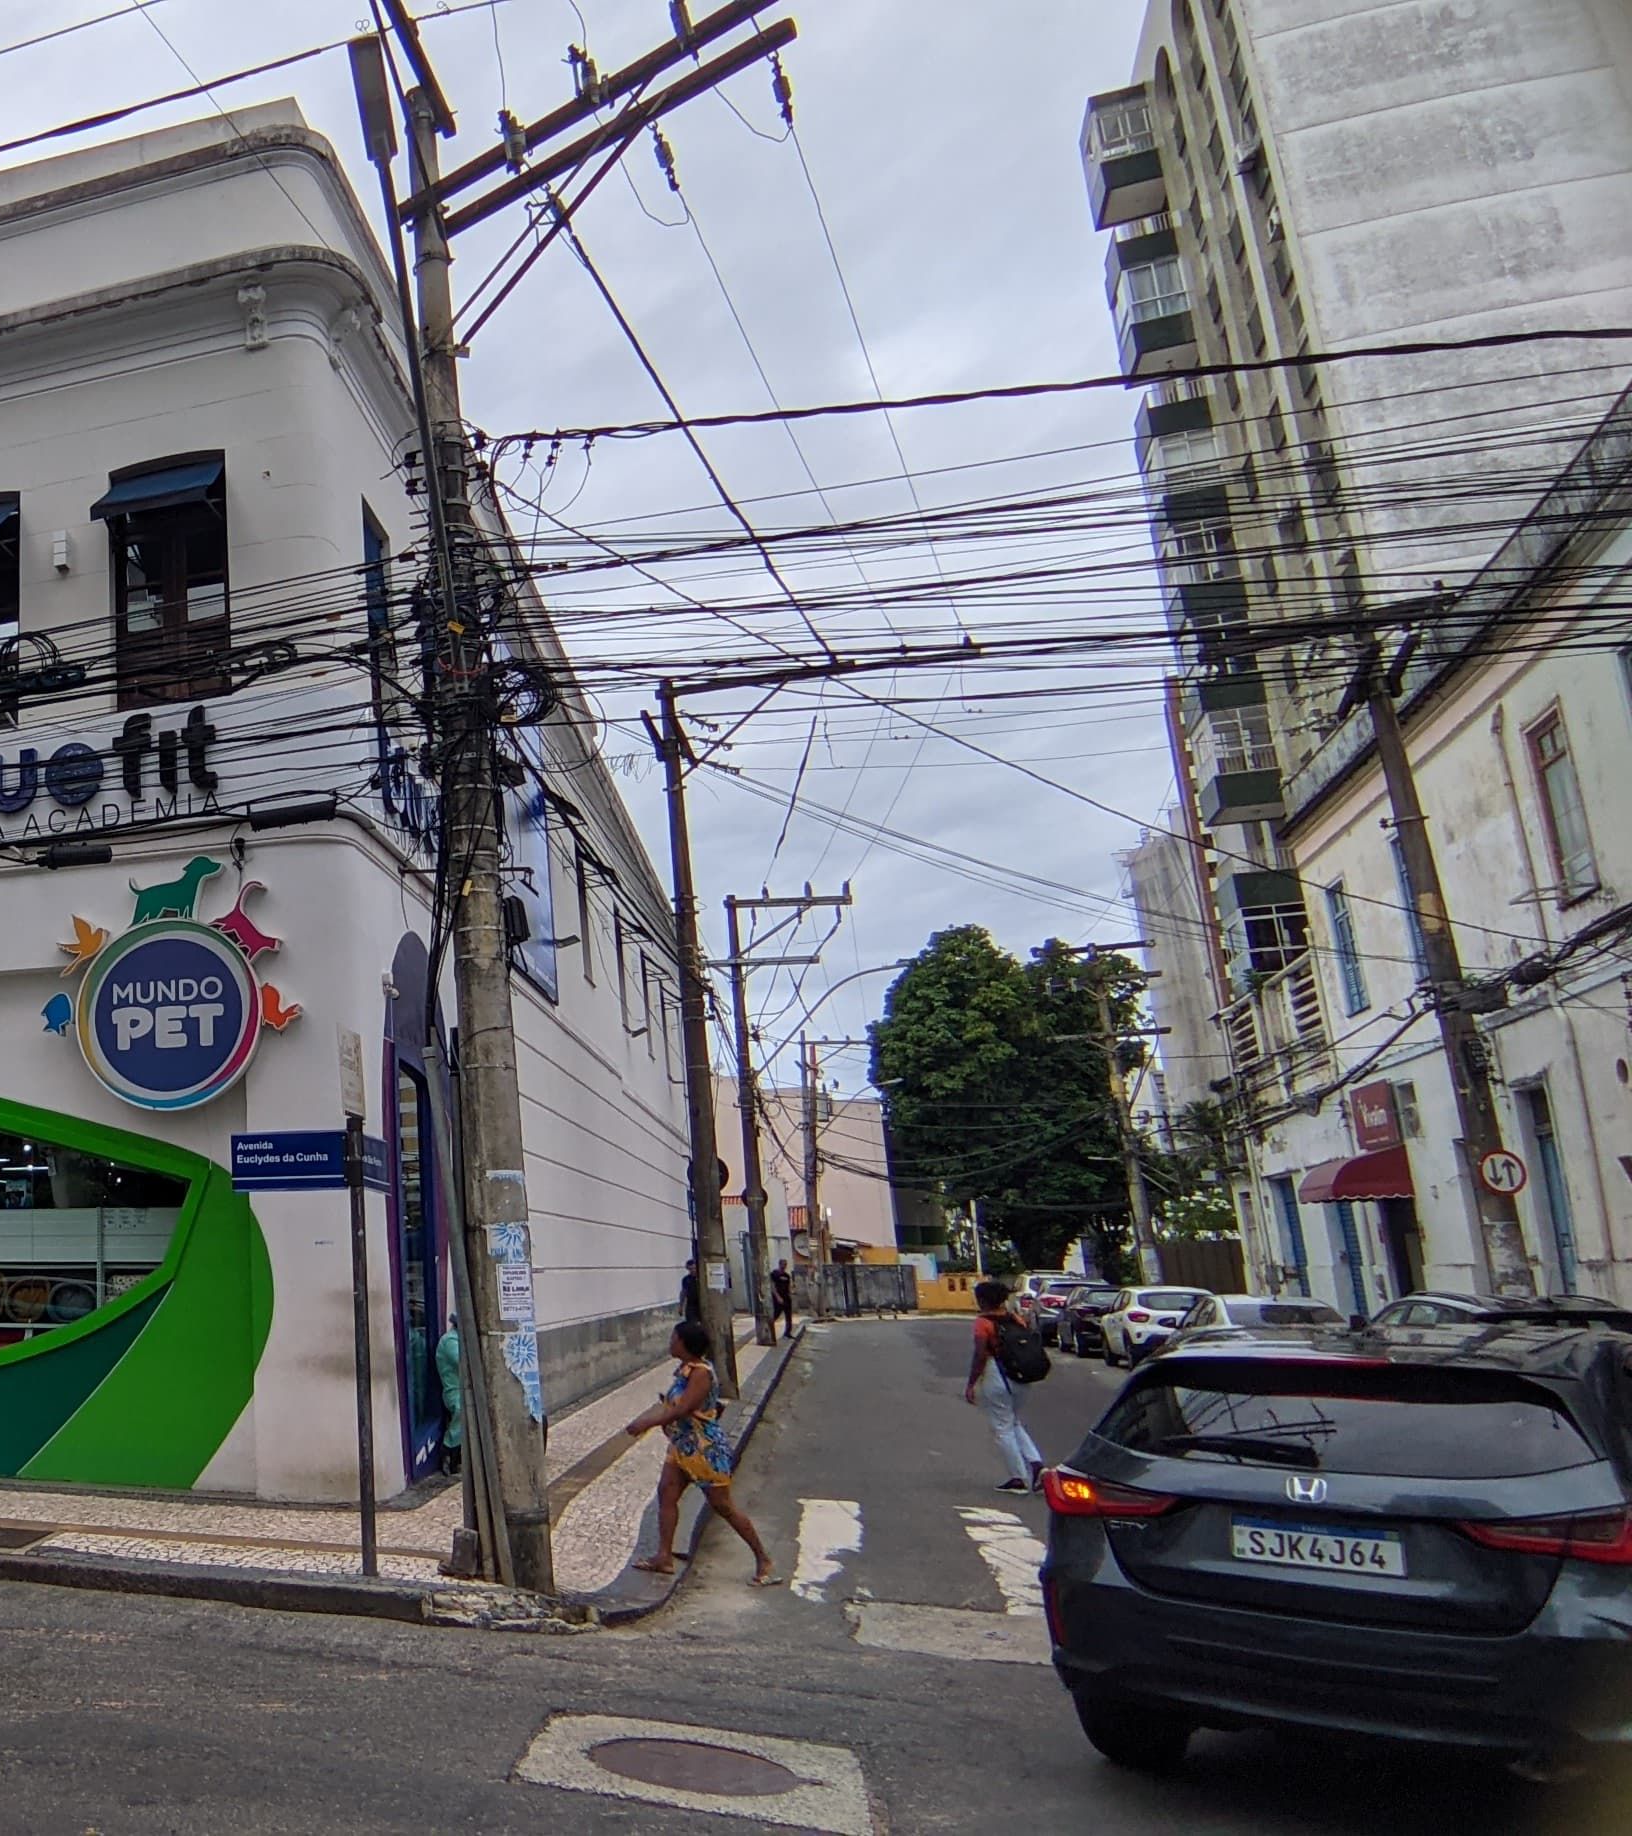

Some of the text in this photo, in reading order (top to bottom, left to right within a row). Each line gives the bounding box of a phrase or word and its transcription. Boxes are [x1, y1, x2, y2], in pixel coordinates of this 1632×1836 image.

[23, 790, 221, 837] ACADEMIA
[113, 976, 224, 1005] MUNDO
[111, 1002, 225, 1052] PET
[236, 1141, 274, 1151] Avenida
[236, 1152, 329, 1166] Euclydes da Cunha
[1249, 1531, 1387, 1569] SJK4J64
